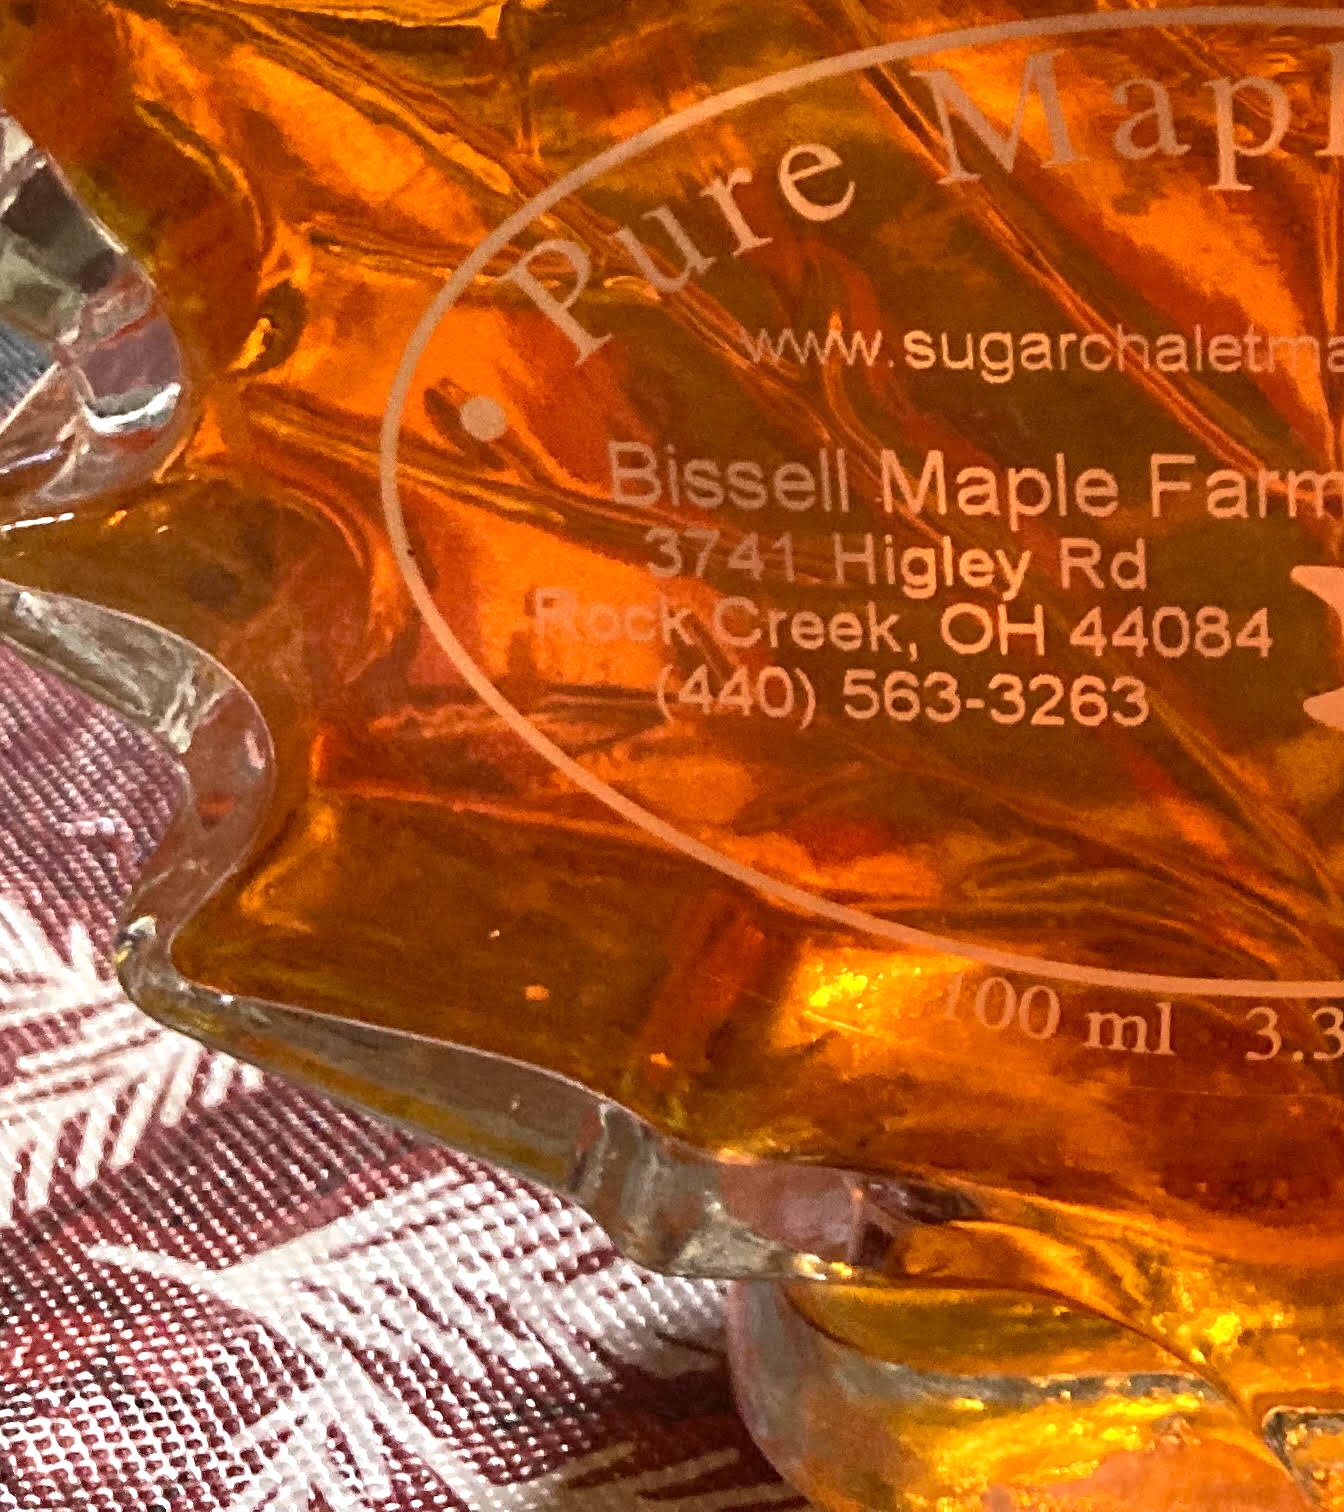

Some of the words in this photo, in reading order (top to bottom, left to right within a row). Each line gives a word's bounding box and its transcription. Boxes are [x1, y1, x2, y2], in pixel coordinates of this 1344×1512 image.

[506, 140, 858, 366] Pure
[609, 441, 848, 513] Bissell
[881, 451, 1120, 529] Maple
[645, 528, 798, 580] 3741
[834, 534, 1030, 599] Higley
[1059, 538, 1147, 591] Rd
[531, 587, 694, 646] Rock
[712, 598, 919, 660] Creek,
[940, 602, 1045, 657] OH
[1069, 605, 1273, 659] 44084
[655, 666, 816, 729] (440)
[844, 669, 1150, 727] 563-3263
[941, 969, 1059, 1040] 100
[1083, 1002, 1177, 1057] ml
